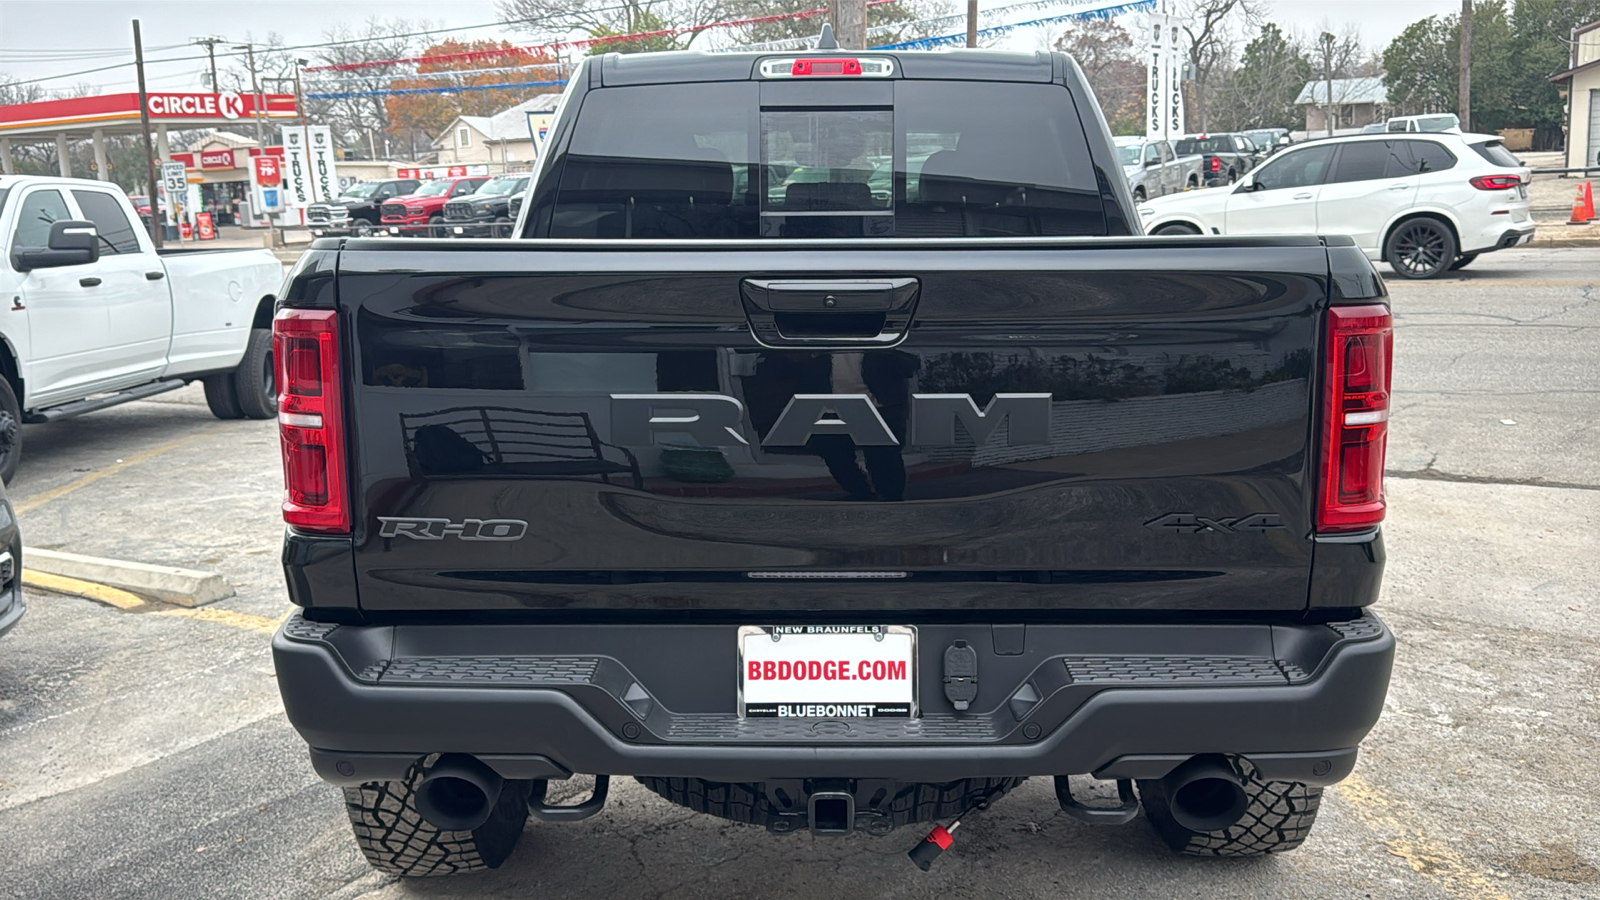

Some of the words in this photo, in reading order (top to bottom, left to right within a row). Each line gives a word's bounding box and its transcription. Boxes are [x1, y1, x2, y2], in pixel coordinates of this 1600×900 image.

[1151, 53, 1160, 131] TRUCKS
[1171, 54, 1180, 131] UCKS
[148, 95, 216, 114] CIRCLE
[222, 94, 243, 119] K
[167, 177, 186, 190] 35
[291, 152, 306, 202] TRUCKS
[316, 151, 331, 201] TRUCKS
[609, 393, 1053, 447] RAM
[377, 516, 528, 541] RHO
[775, 626, 803, 634] NEW
[807, 626, 880, 634] BRAUNFELS
[747, 660, 907, 681] BBDODGE.COM
[778, 705, 877, 717] BLUEBONNET
